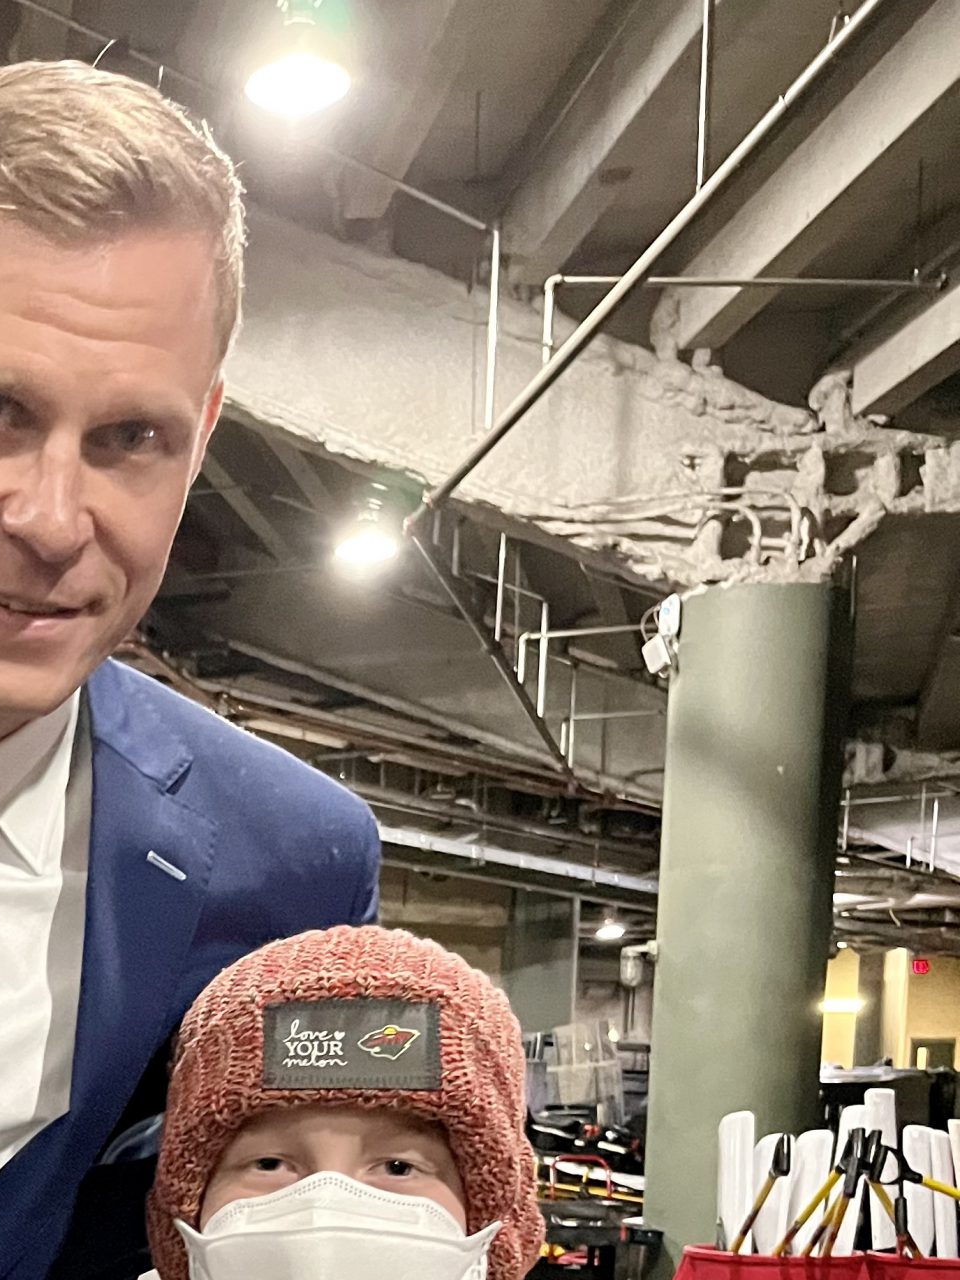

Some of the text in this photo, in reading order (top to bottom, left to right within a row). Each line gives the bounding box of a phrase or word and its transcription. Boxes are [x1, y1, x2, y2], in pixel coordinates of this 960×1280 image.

[283, 1019, 332, 1042] love
[285, 1040, 344, 1057] YOUR
[282, 1055, 348, 1068] melon
